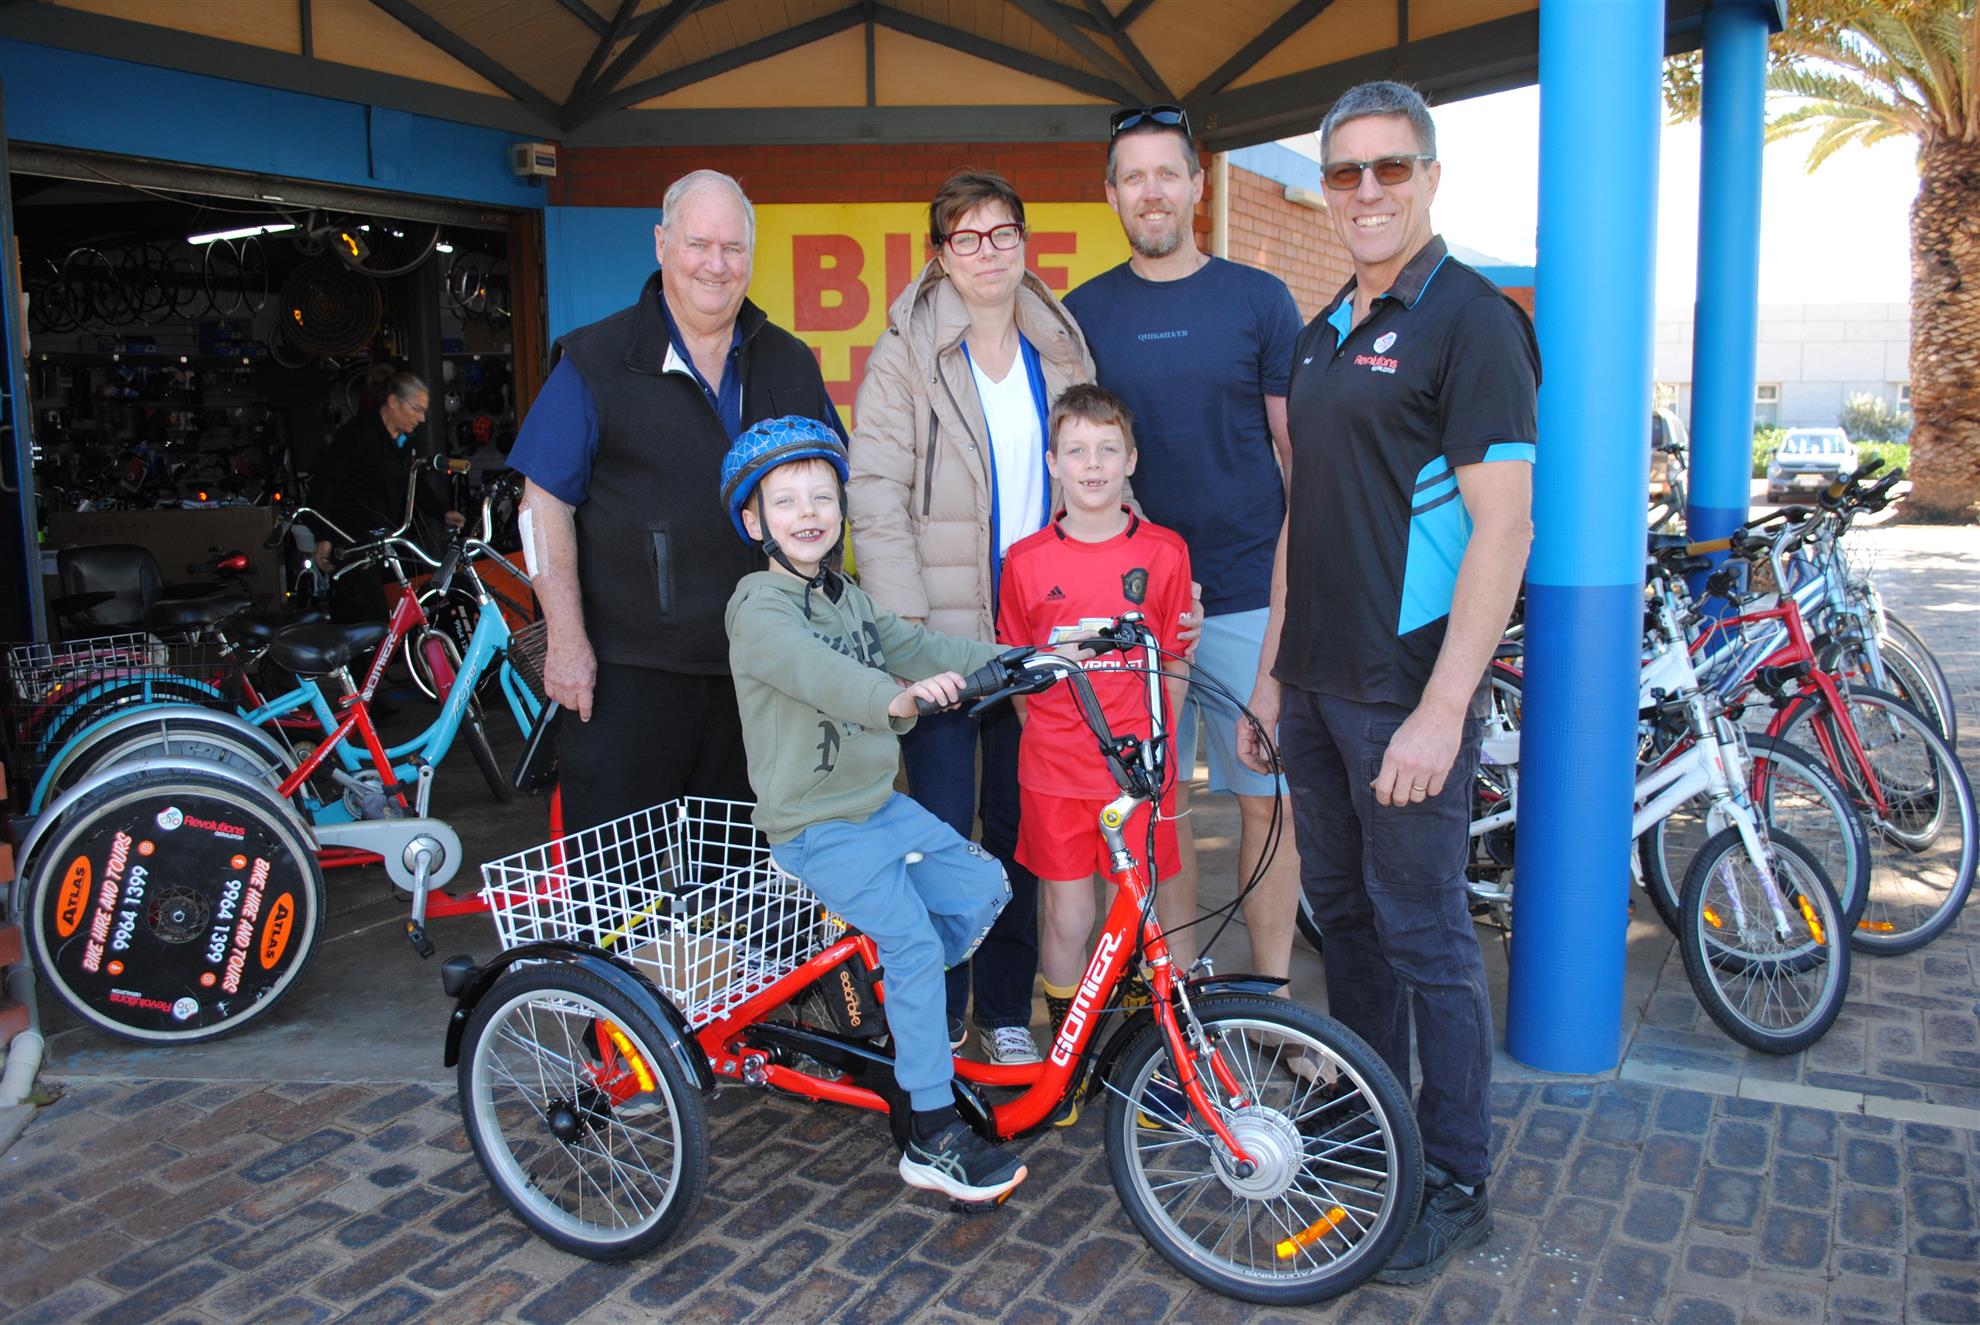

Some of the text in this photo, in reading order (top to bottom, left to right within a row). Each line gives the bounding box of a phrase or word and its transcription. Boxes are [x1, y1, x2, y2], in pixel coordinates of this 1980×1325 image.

[792, 233, 1077, 331] BIE
[1077, 659, 1143, 672] VROLET
[1809, 764, 1839, 791] GIANT
[183, 815, 246, 835] Revolutions
[62, 867, 85, 926] ATLAS
[83, 831, 132, 972] BIKE HIRE AND TOURS
[113, 865, 149, 950] 9964 1399
[207, 880, 242, 963] 9964 1399
[222, 857, 271, 994] BIKE HIRE AND TOURS
[266, 904, 288, 959] ATLAS
[110, 994, 172, 1013] Revolutions
[1051, 931, 1122, 1067] GOMIER
